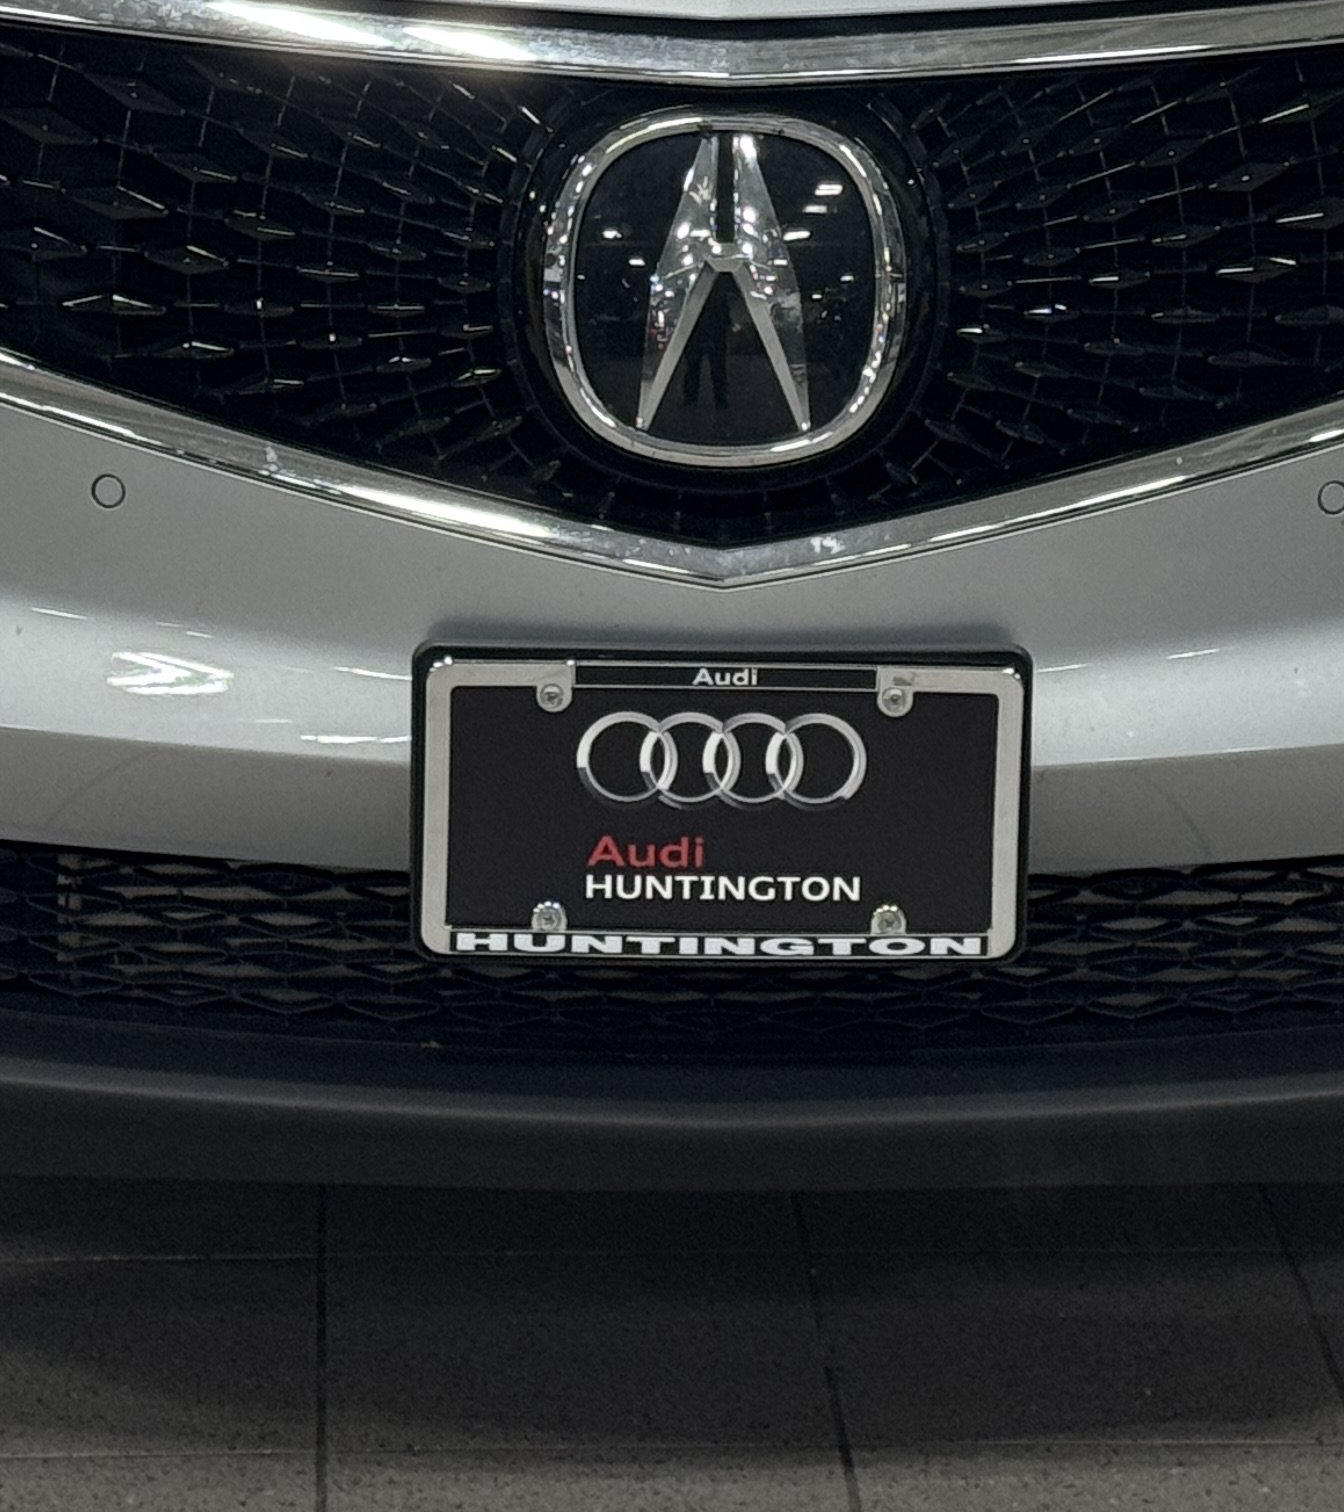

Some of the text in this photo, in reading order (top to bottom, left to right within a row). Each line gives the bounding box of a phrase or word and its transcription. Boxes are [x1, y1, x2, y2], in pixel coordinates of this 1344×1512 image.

[692, 667, 757, 687] Audi
[587, 835, 705, 868] Audi
[585, 874, 861, 902] HUNTINGTON
[456, 933, 983, 956] HUNTINGTON
